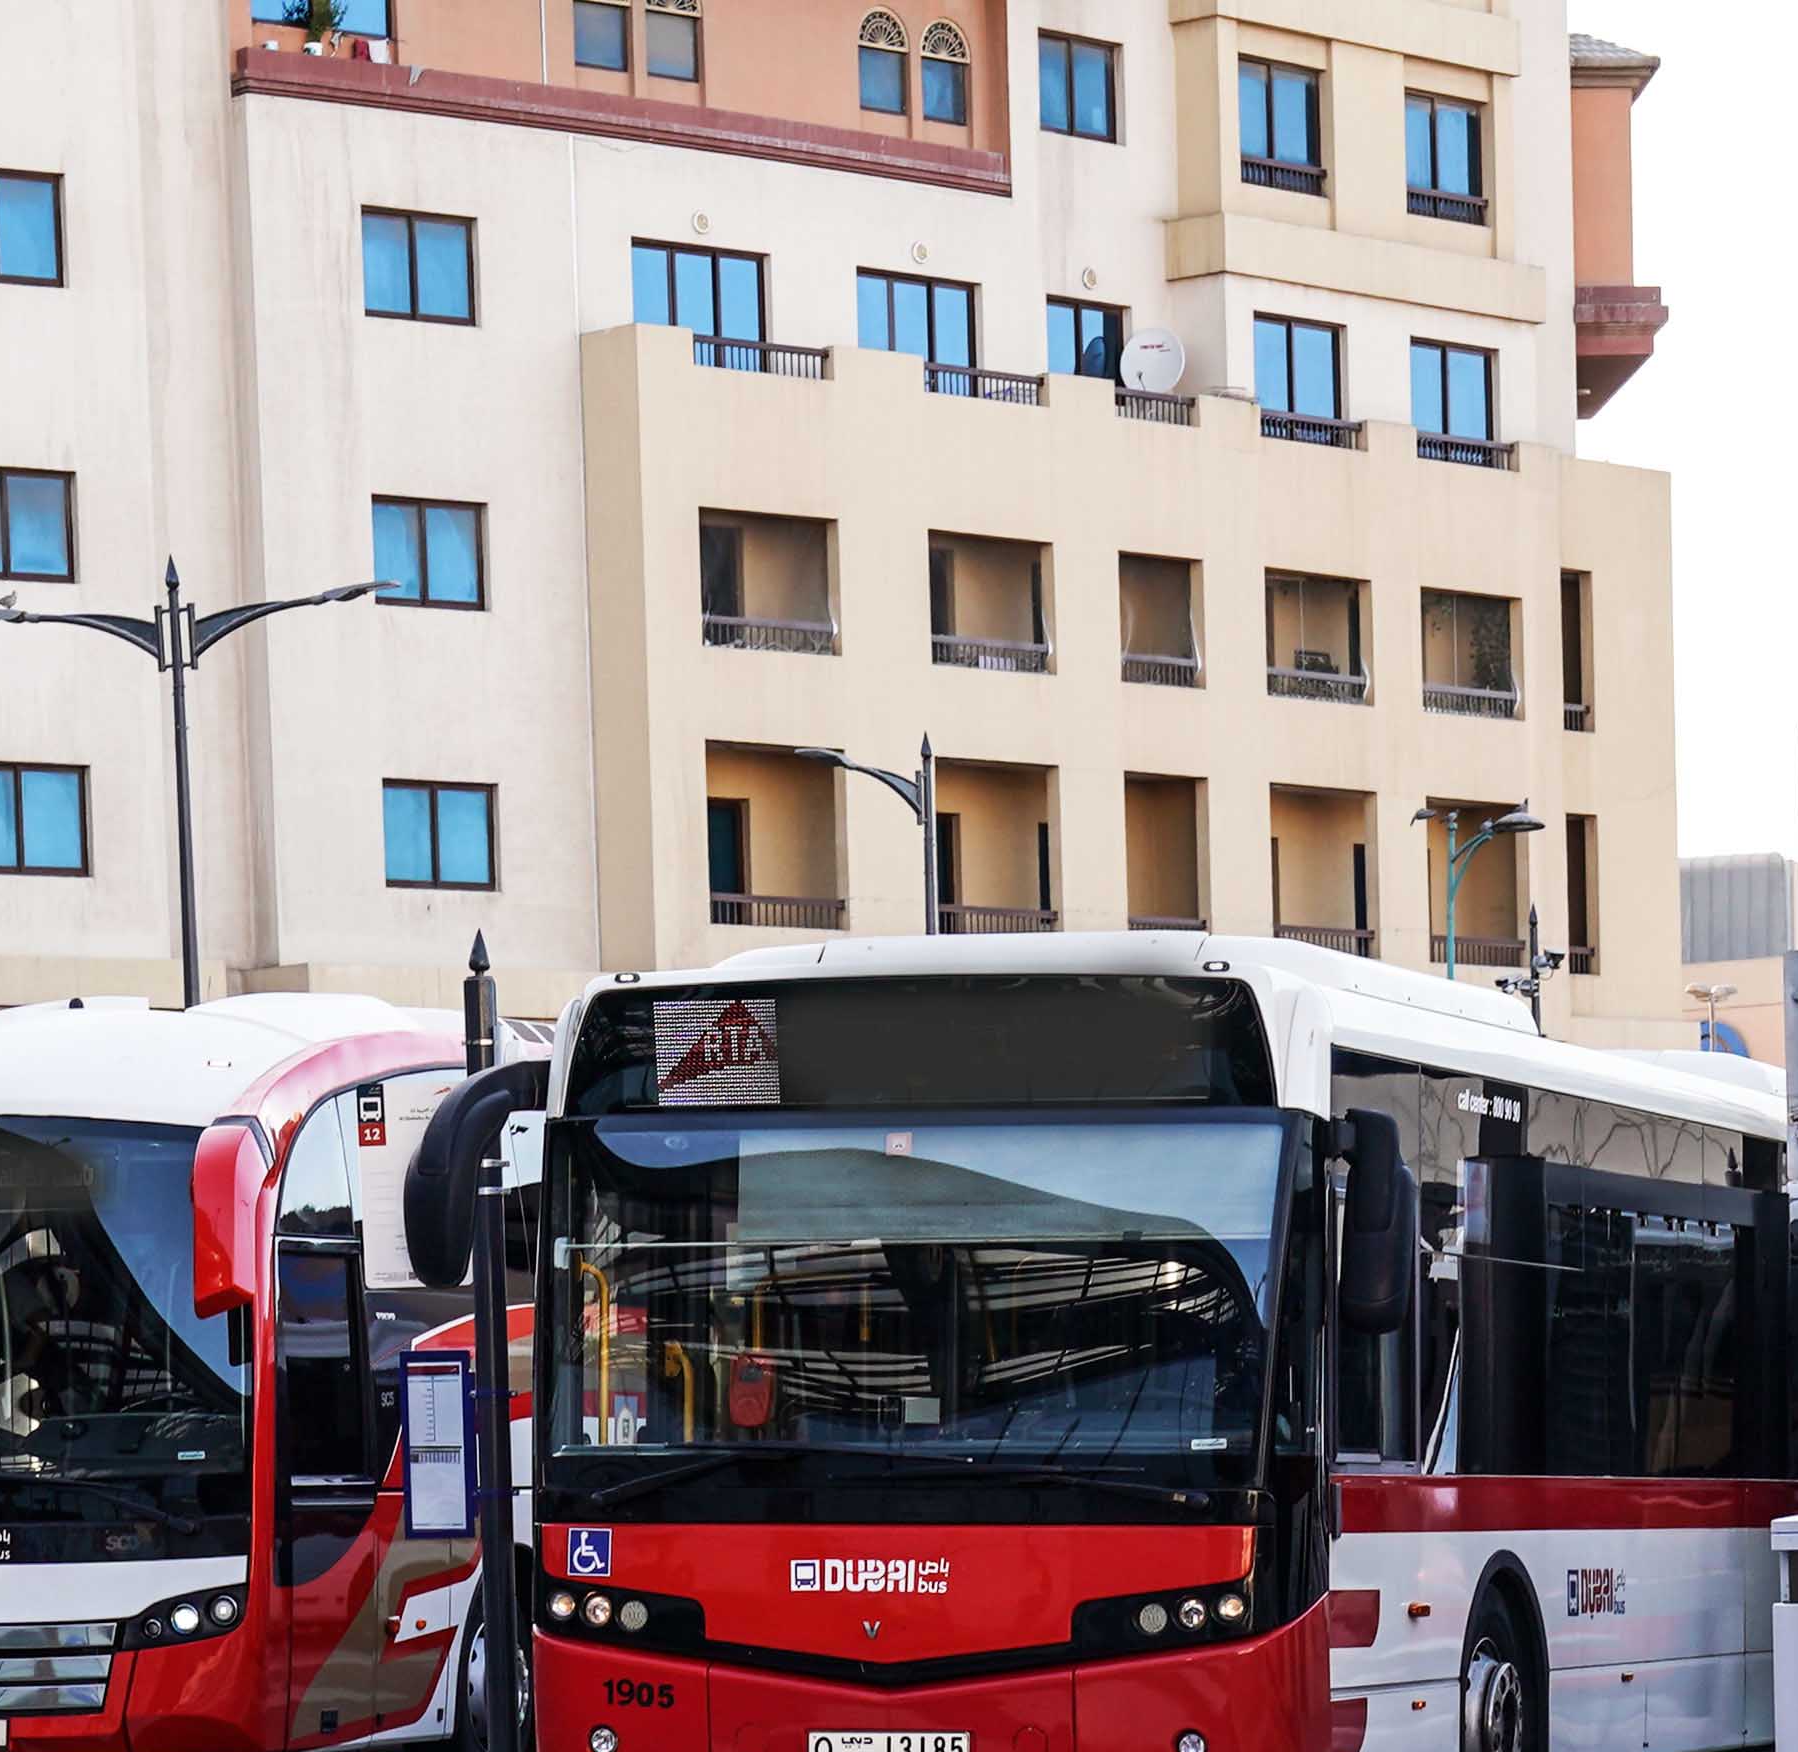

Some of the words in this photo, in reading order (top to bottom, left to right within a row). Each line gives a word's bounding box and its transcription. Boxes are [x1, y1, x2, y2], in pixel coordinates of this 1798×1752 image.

[703, 1025, 766, 1061] RTA
[363, 1128, 381, 1141] 12
[823, 1558, 916, 1593] DUBAI
[917, 1577, 948, 1594] bus
[1581, 1568, 1614, 1620] DUBAI
[862, 1620, 881, 1639] V
[602, 1678, 675, 1709] 1905
